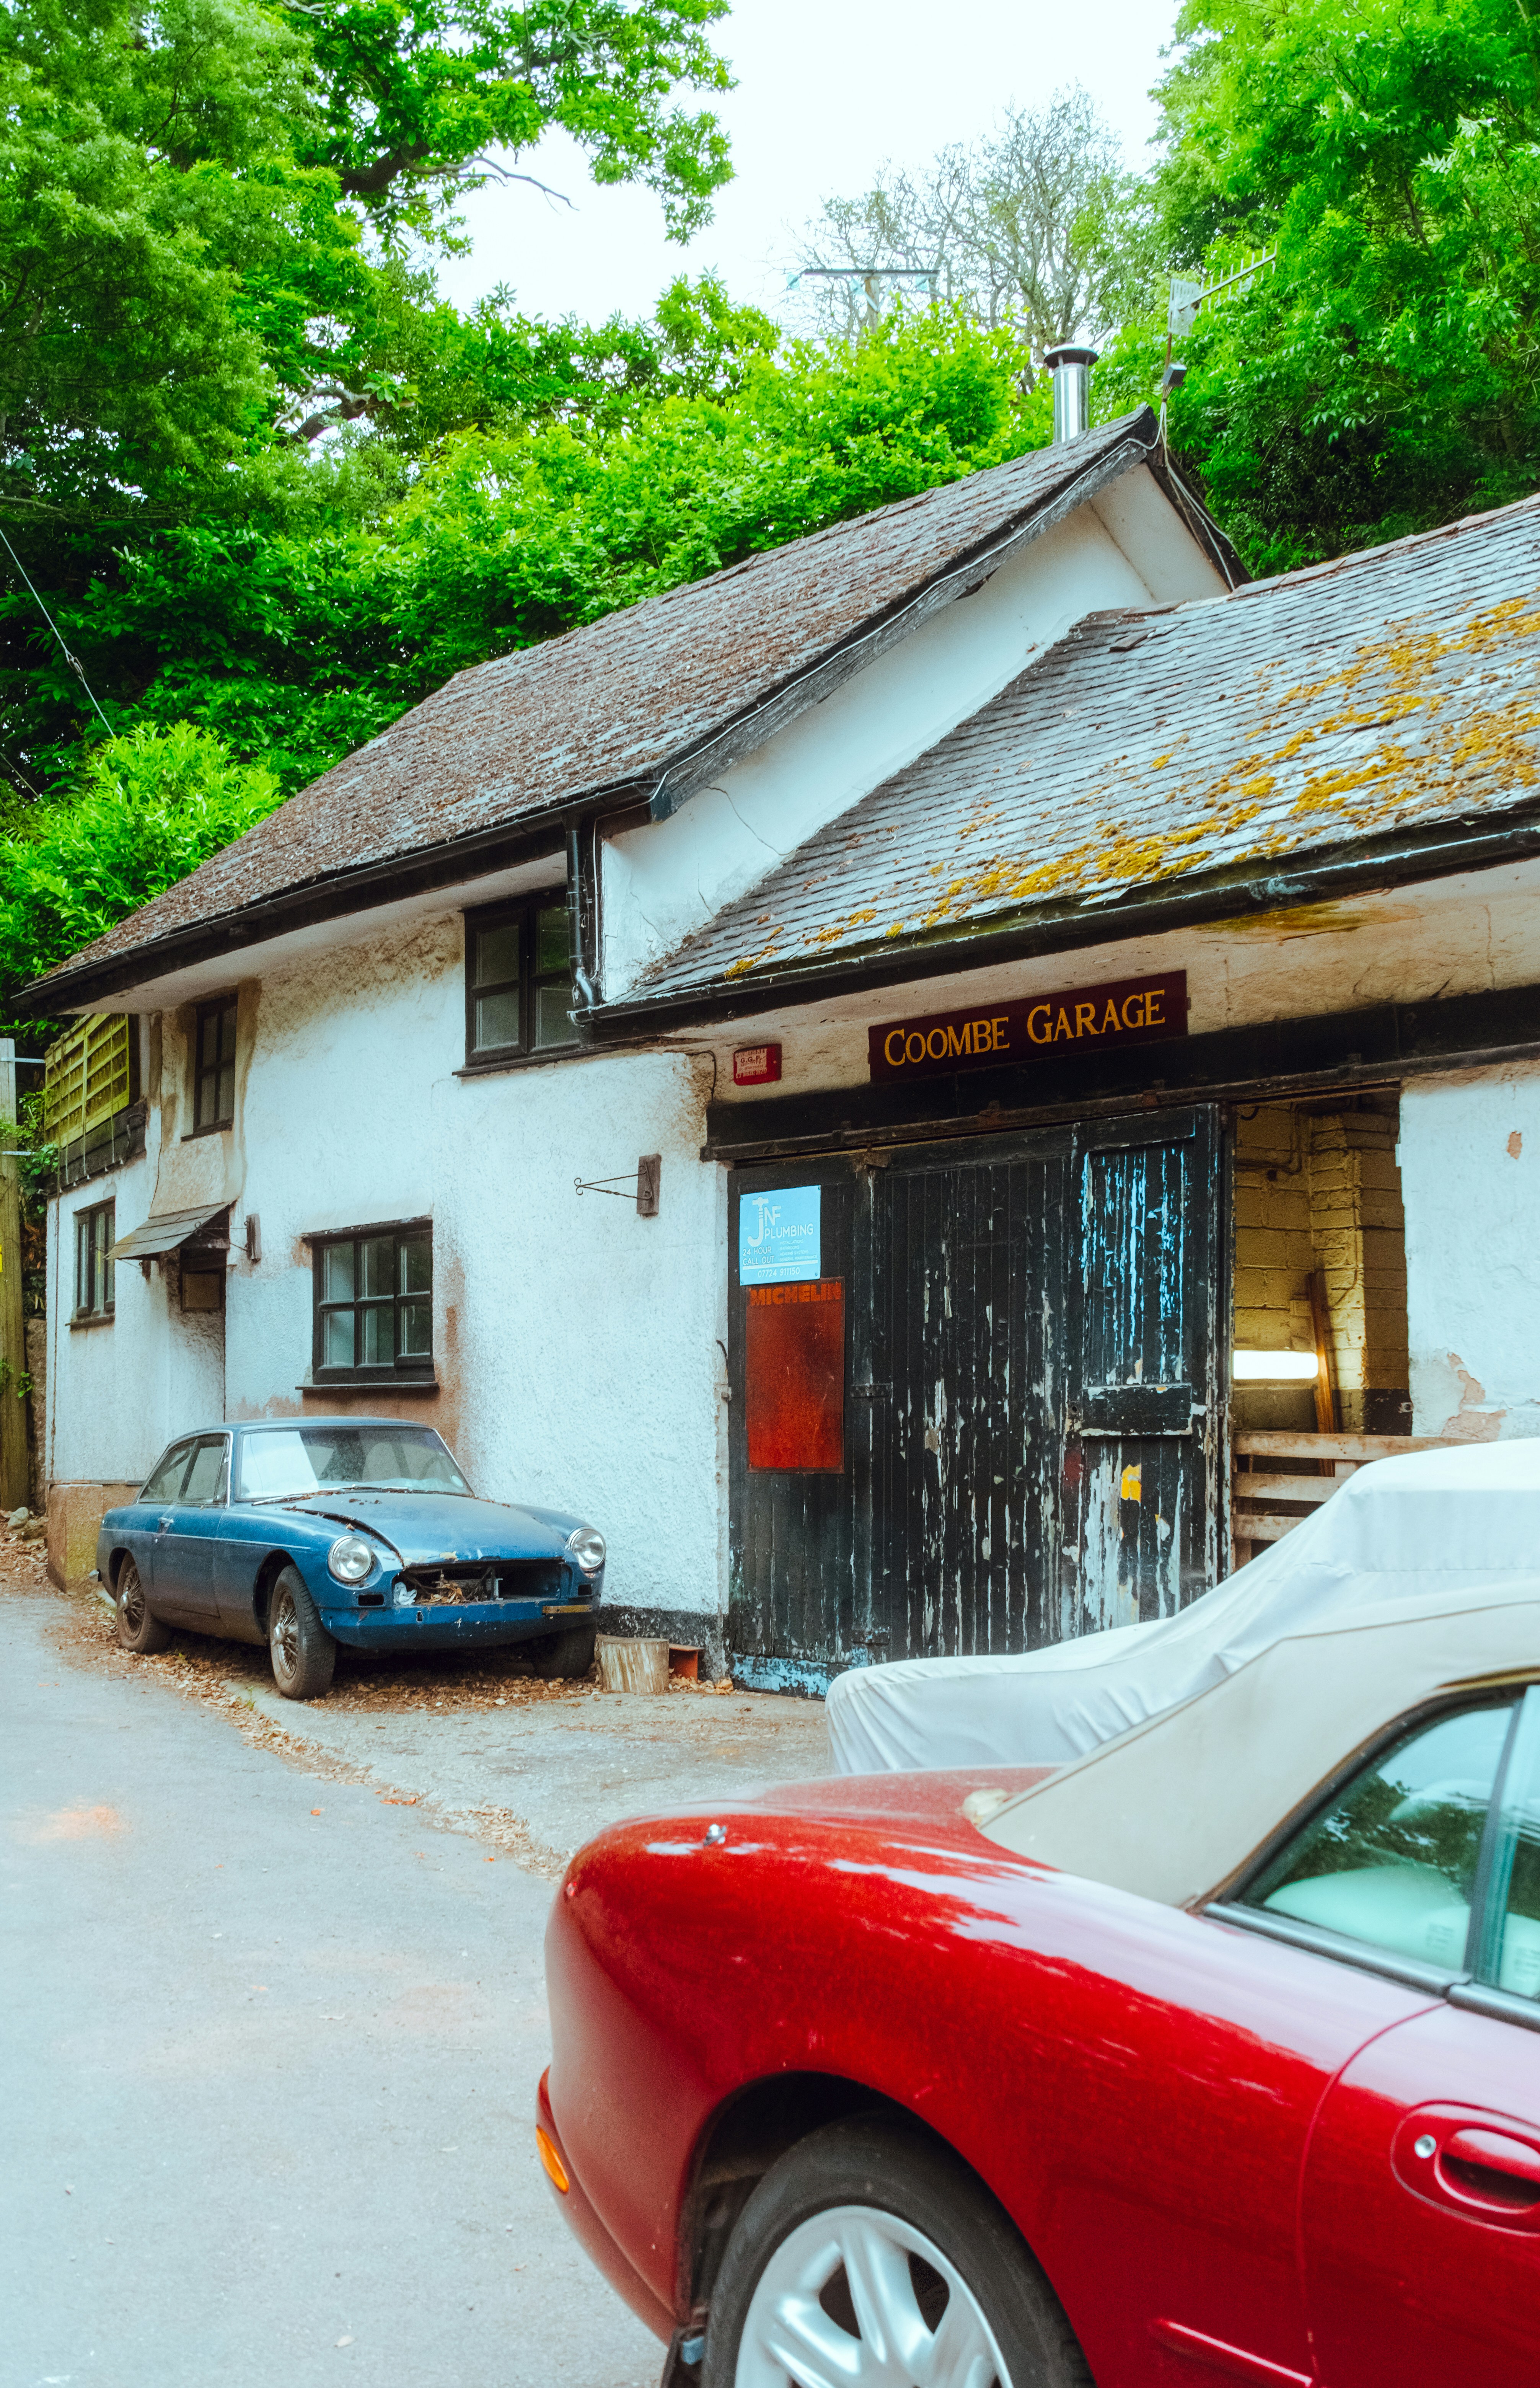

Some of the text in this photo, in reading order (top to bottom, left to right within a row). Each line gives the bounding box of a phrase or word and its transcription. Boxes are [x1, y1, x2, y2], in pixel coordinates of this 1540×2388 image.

[885, 989, 1166, 1066] COOMBE GARAGE
[765, 1223, 813, 1239] PLUMBING
[743, 1246, 772, 1256] 24 HOUR
[743, 1255, 775, 1266] CALL OUT
[758, 1267, 800, 1278] 07724 911150
[750, 1282, 842, 1306] MICHELIN
